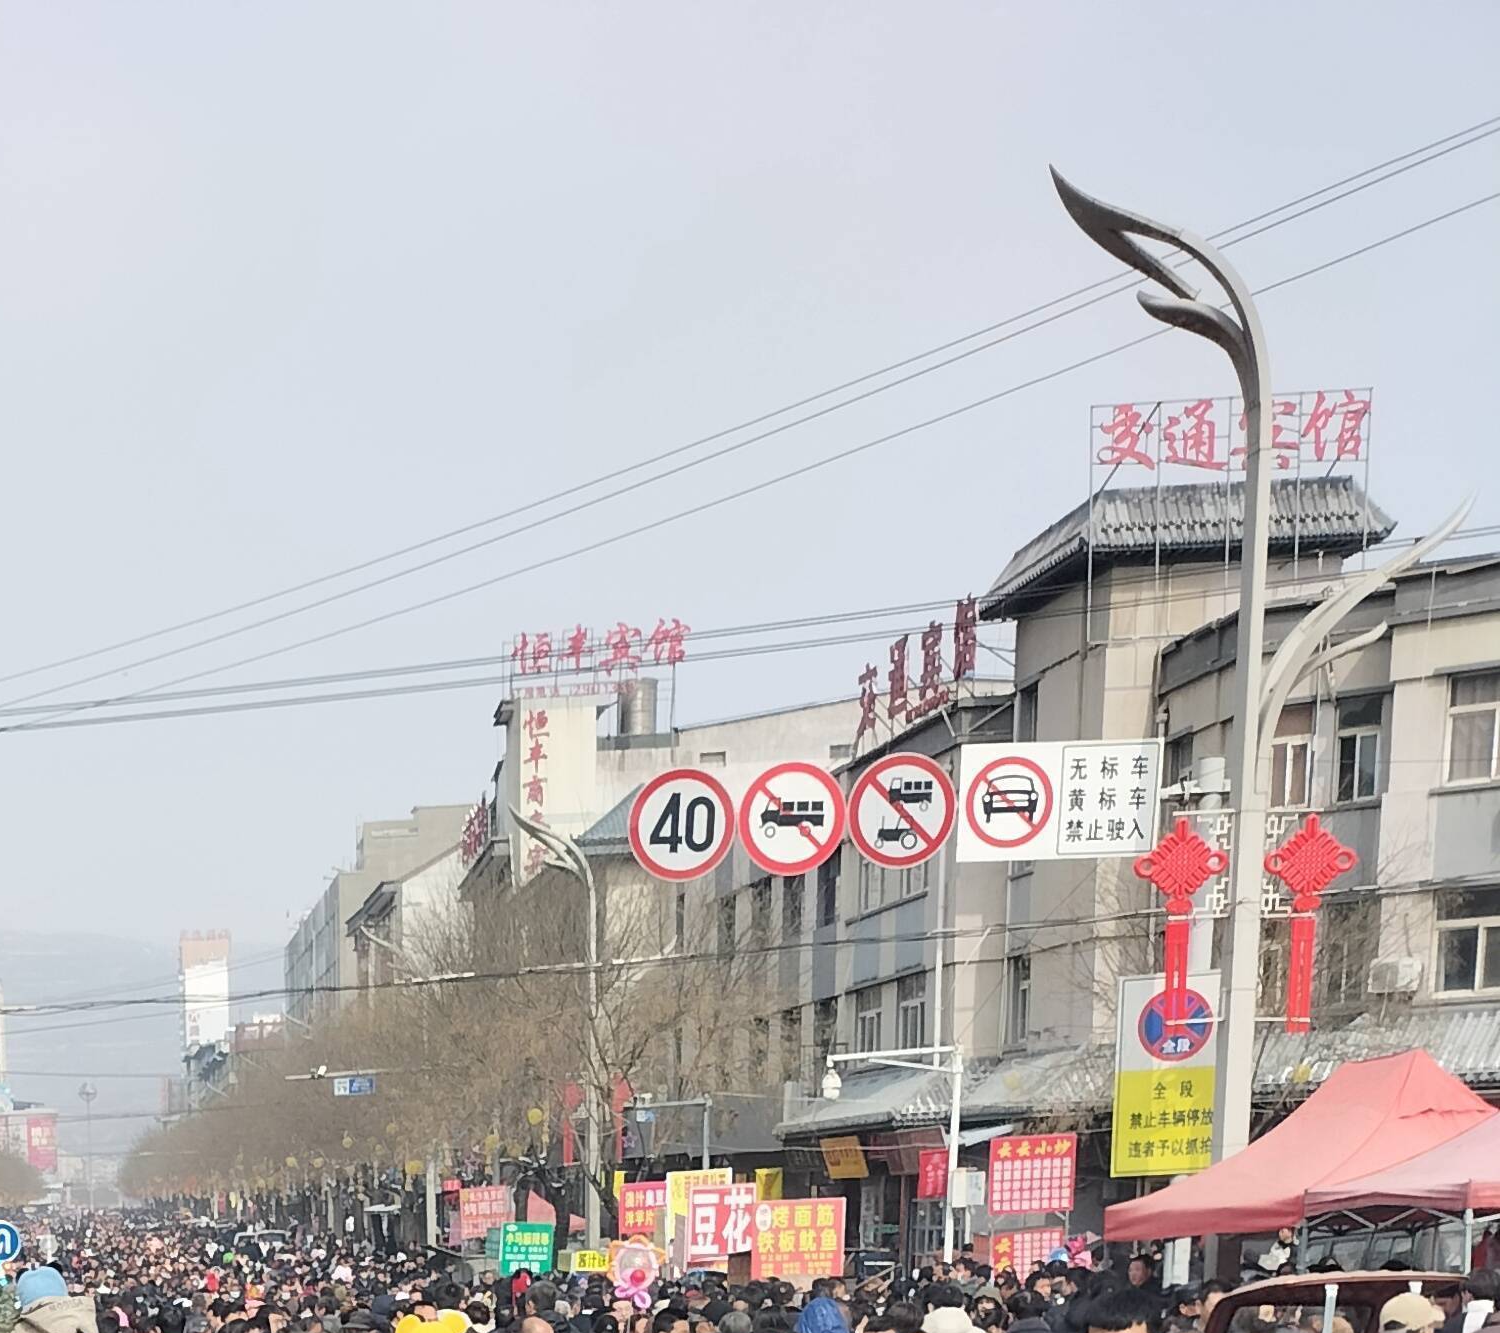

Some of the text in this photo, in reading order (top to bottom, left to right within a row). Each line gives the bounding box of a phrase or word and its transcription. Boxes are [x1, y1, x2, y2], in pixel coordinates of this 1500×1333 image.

[511, 617, 691, 676] 恒丰宾馆
[1069, 755, 1149, 780] 无标车
[1068, 786, 1147, 812] 黄标车
[649, 791, 715, 853] 40
[1065, 817, 1145, 843] 禁止驶入
[1161, 1037, 1192, 1055] 全段
[1153, 1080, 1195, 1100] 全段
[1128, 1108, 1214, 1130] 禁止车辆停放
[690, 1187, 753, 1255] 豆花
[771, 1202, 836, 1229] 烤面筋
[757, 1229, 838, 1253] 铁板鱿鱼
